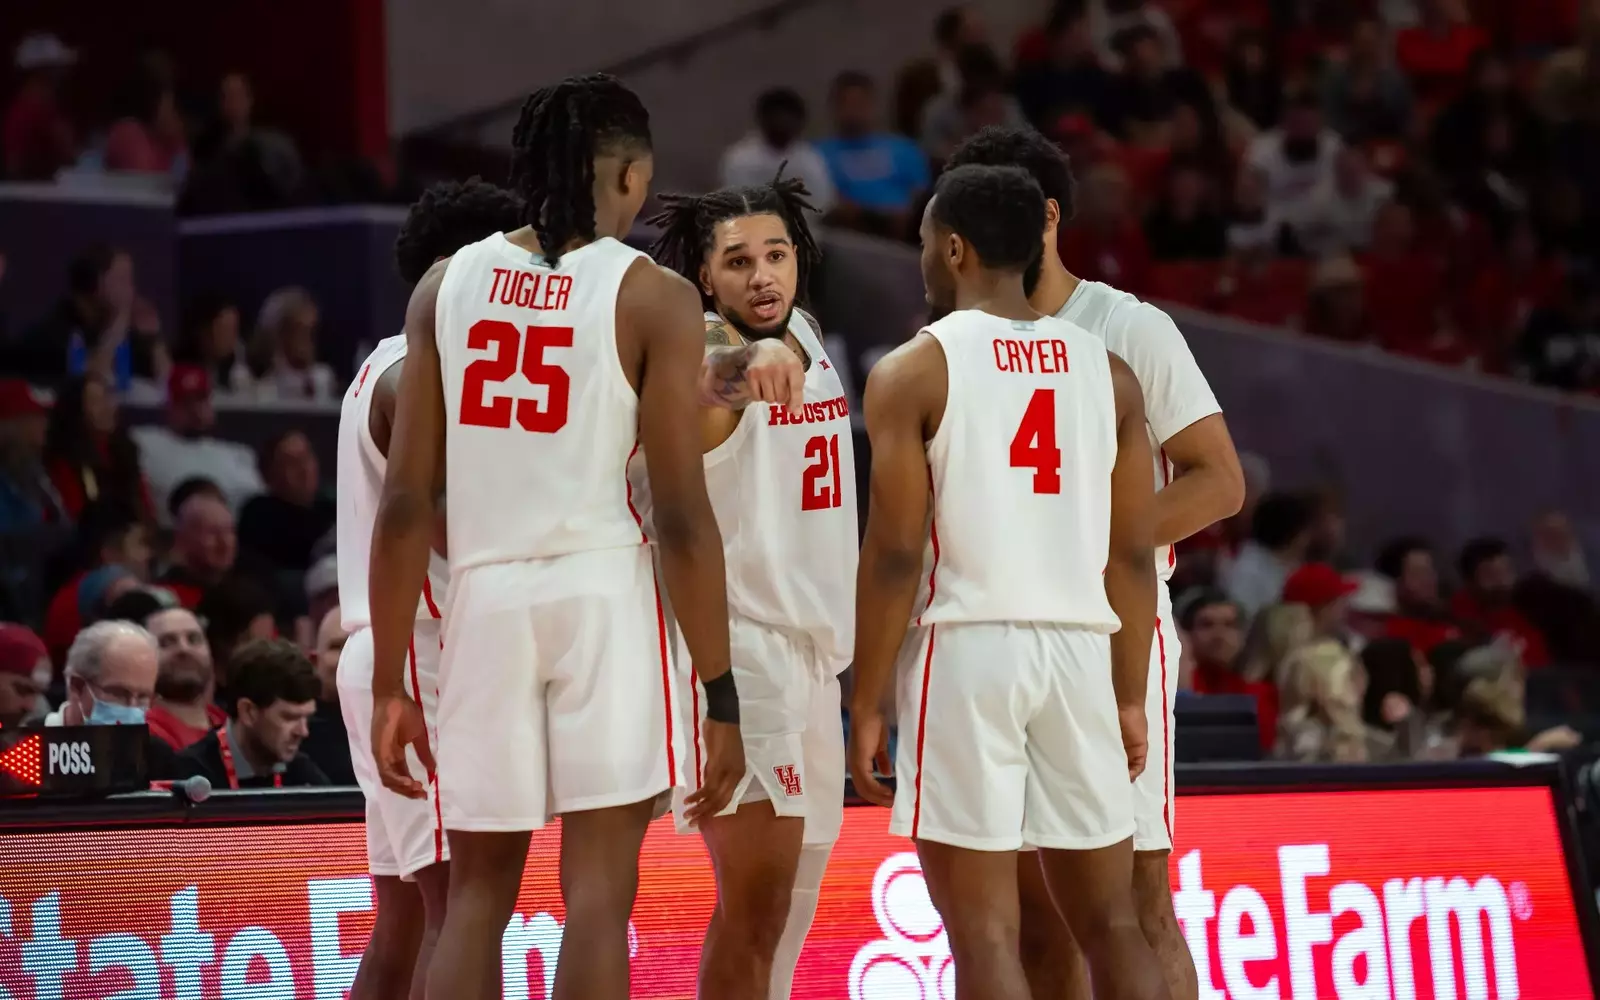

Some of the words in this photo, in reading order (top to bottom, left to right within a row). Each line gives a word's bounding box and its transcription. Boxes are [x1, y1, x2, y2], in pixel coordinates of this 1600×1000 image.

[488, 267, 574, 311] TUGLER
[459, 318, 575, 434] 25
[992, 338, 1070, 374] CRYER
[1009, 388, 1062, 495] 4
[801, 433, 843, 511] 21
[48, 741, 96, 775] POSS.
[772, 764, 803, 797] UH
